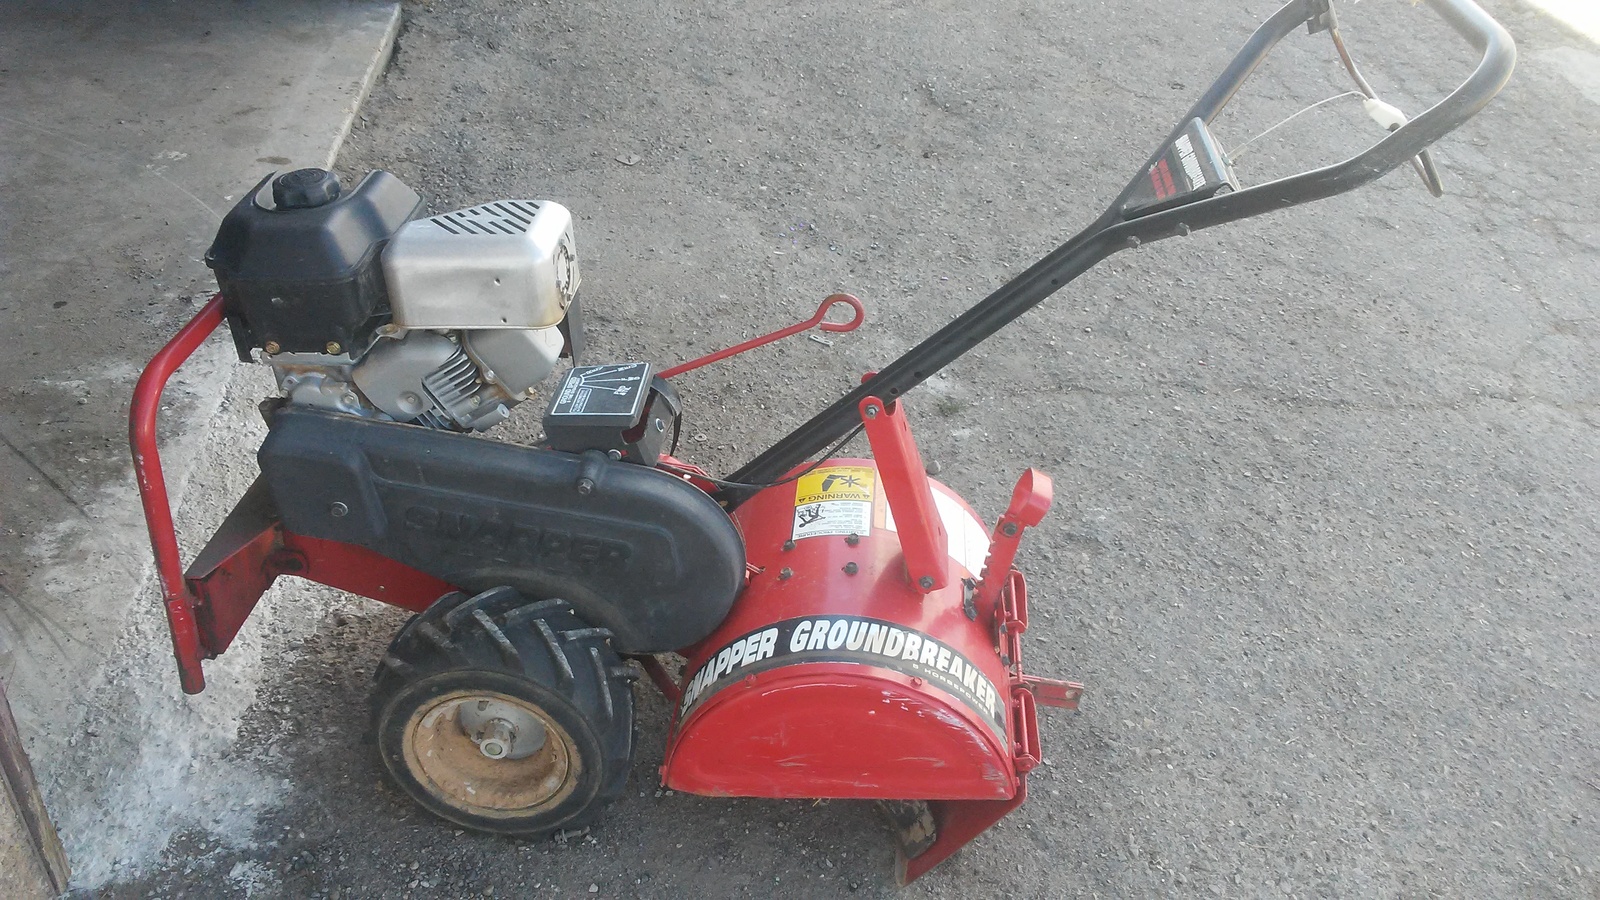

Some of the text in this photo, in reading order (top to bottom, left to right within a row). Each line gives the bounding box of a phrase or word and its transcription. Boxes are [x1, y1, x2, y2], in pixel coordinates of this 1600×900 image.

[808, 491, 861, 500] WARNING
[404, 505, 635, 566] SNAPPER
[680, 619, 997, 719] SNAPPER GROUNDBREAKER
[924, 668, 989, 714] HORSEPOWER
